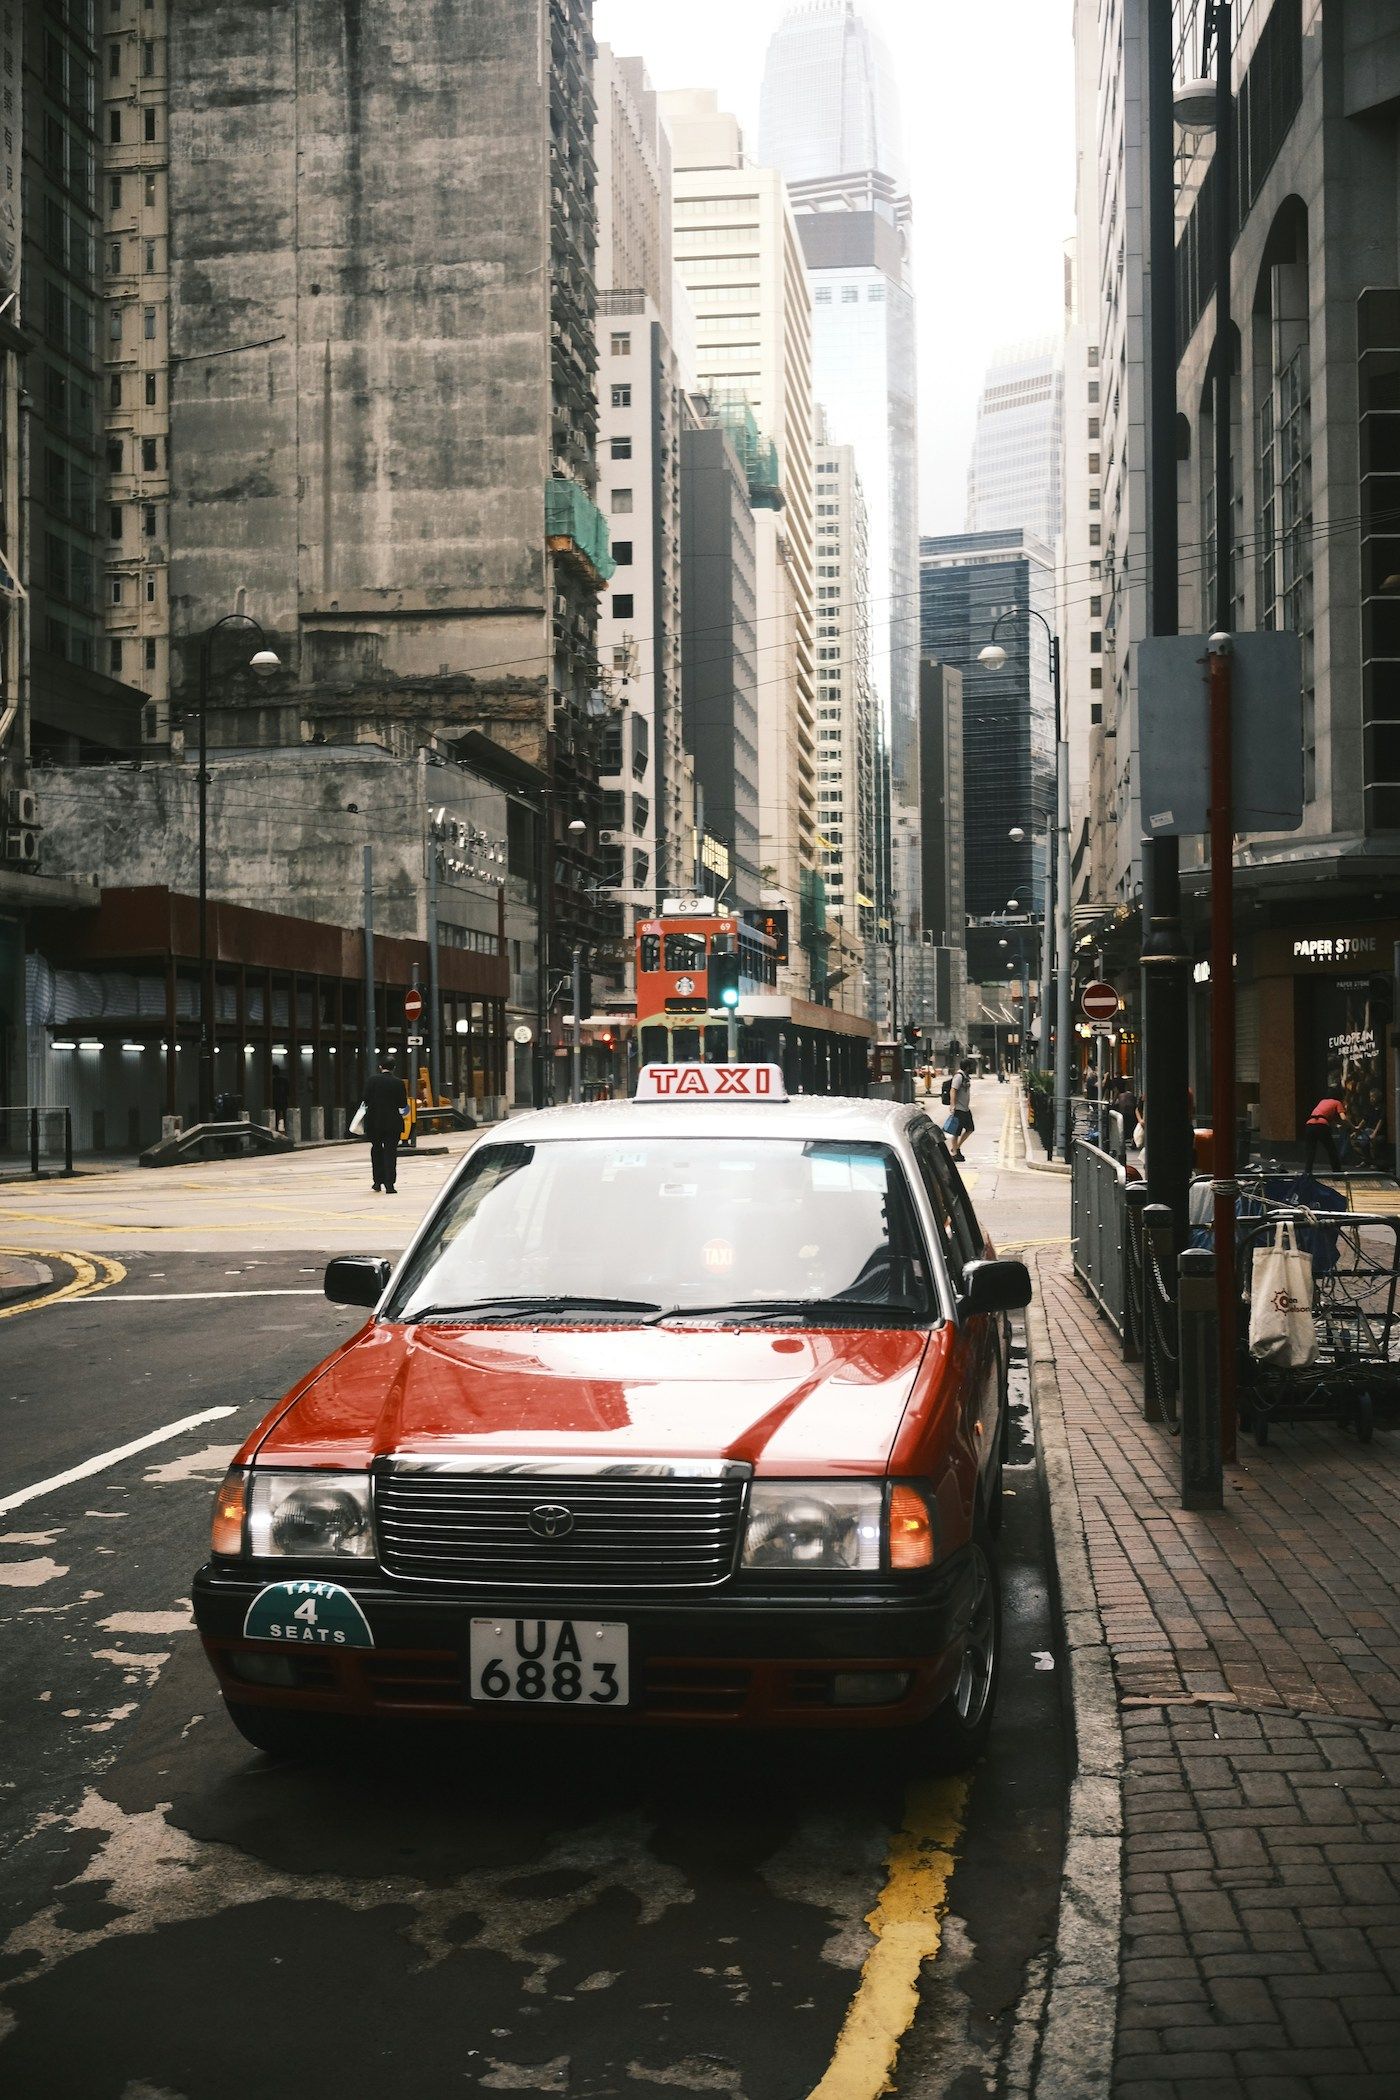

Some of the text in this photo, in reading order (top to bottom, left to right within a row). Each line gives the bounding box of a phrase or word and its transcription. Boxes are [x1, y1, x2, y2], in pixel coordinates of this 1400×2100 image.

[678, 900, 698, 912] 69
[641, 923, 651, 932] 69
[720, 922, 731, 931] 69
[1293, 938, 1376, 956] PAPER STONE
[1328, 1029, 1374, 1049] EUROPEAN
[649, 1068, 770, 1094] TAXI
[703, 1247, 733, 1265] TAXI
[283, 1583, 336, 1600] TAXI
[294, 1598, 318, 1625] 4
[270, 1624, 346, 1643] SEATS
[515, 1620, 582, 1662] UA
[481, 1658, 619, 1703] 6883
